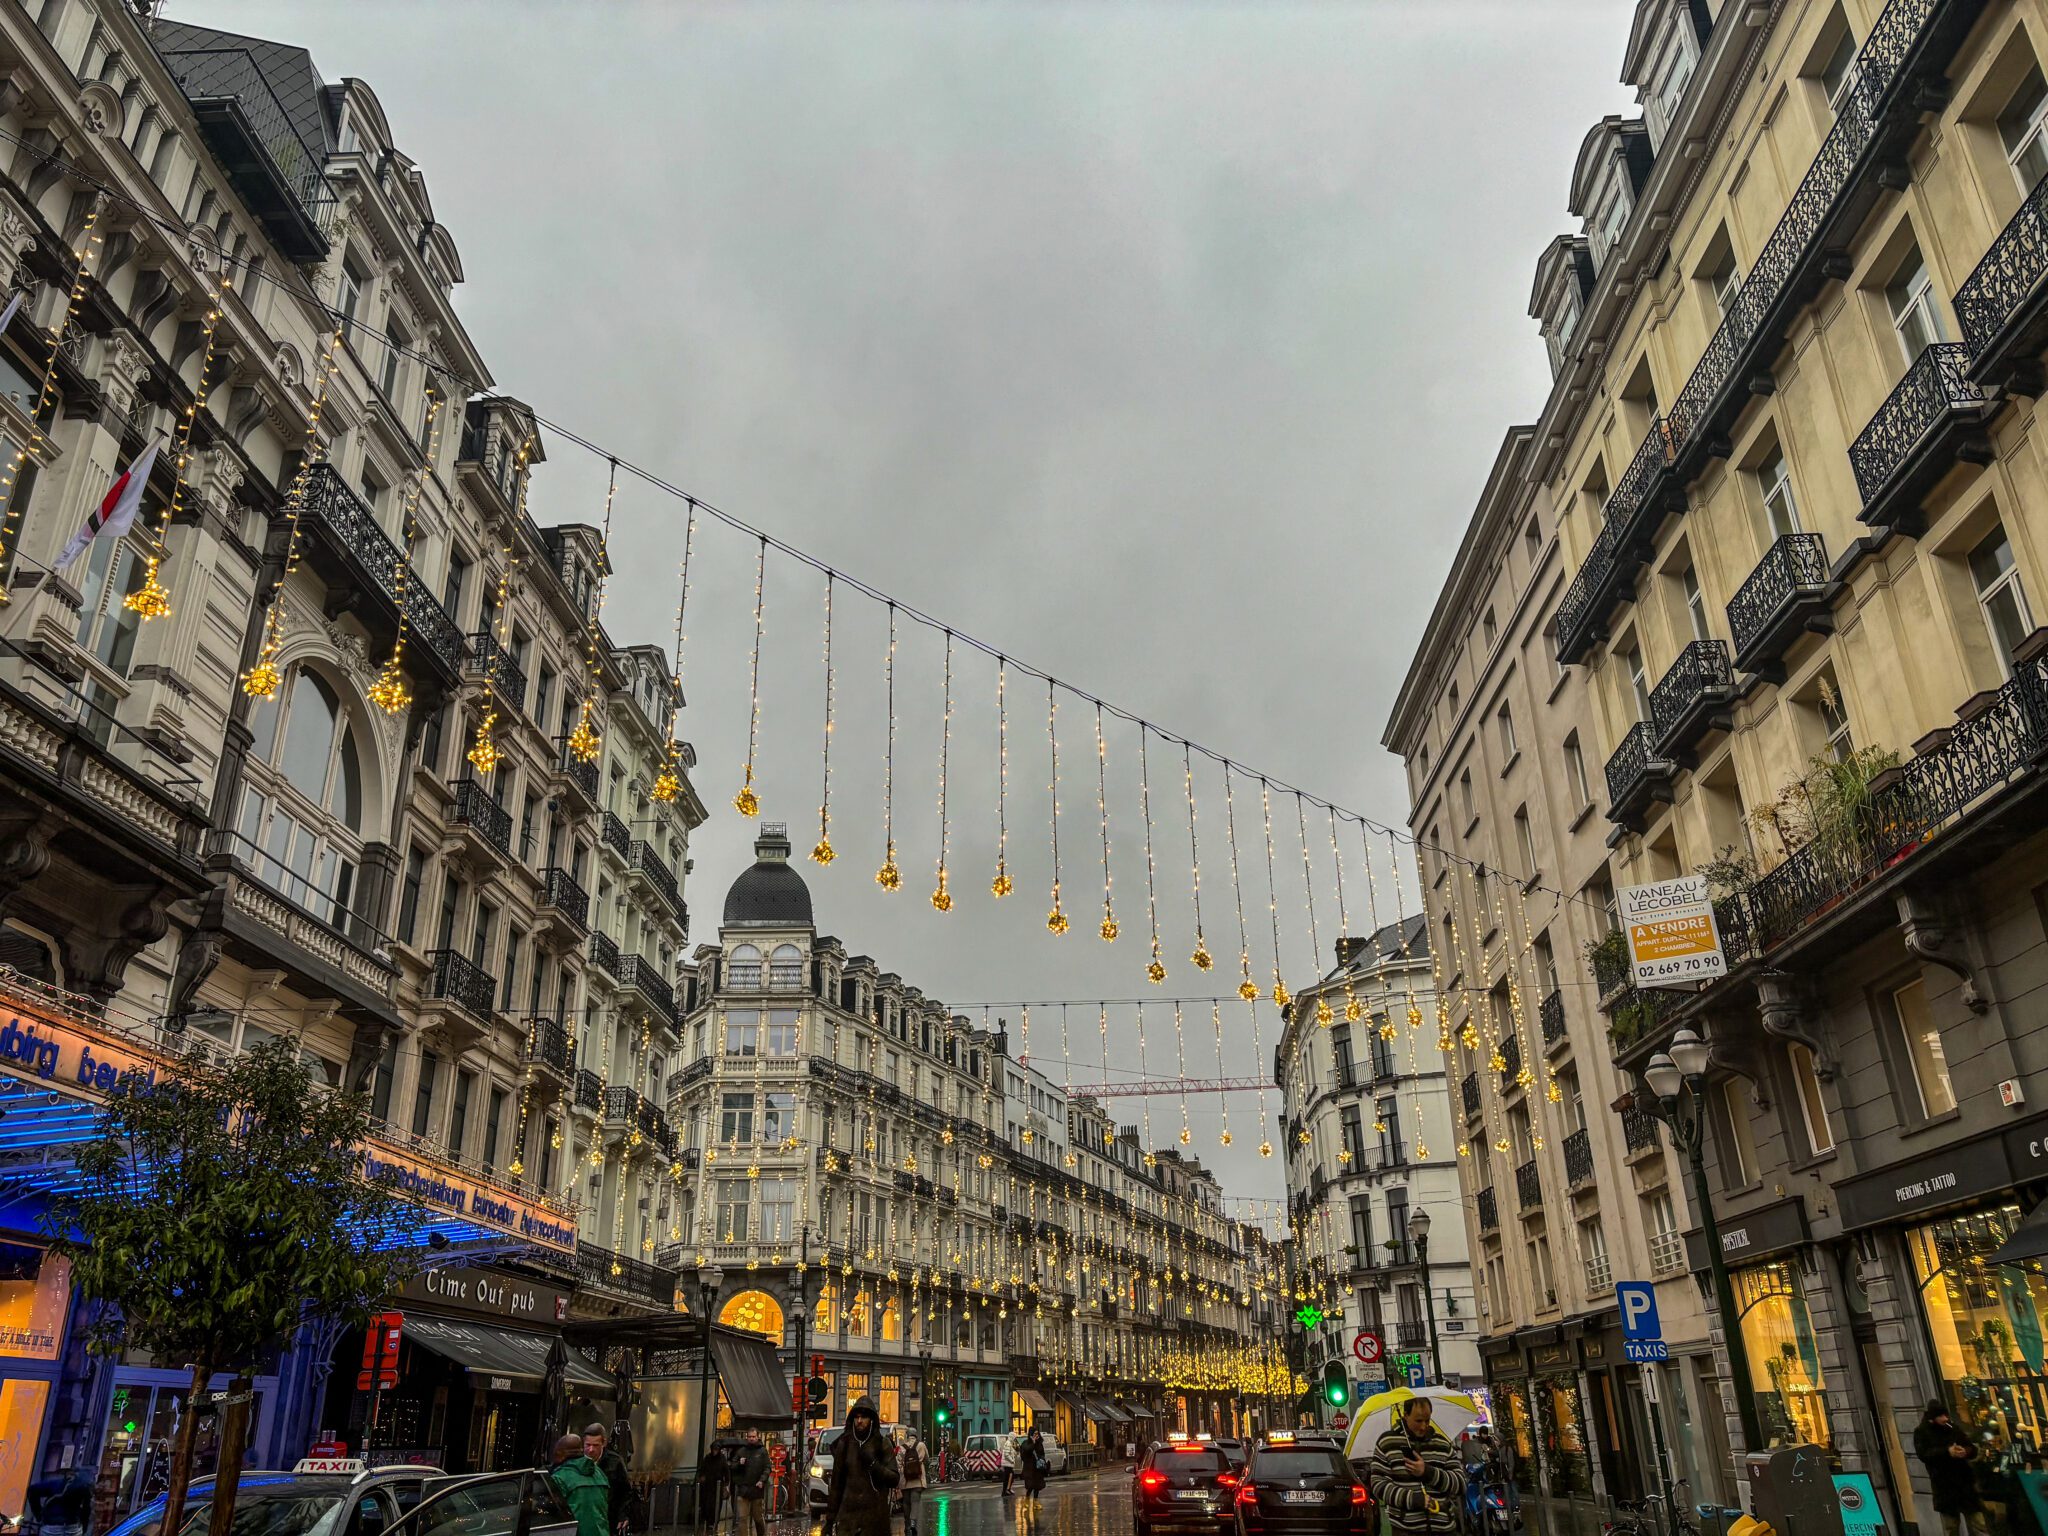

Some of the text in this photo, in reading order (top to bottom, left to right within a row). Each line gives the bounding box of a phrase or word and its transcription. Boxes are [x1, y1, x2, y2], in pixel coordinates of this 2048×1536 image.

[1629, 881, 1697, 901] VANEAU
[1629, 893, 1703, 913] LECOBEL
[1636, 917, 1706, 938] A VENDRE
[1660, 942, 1696, 952] CHAMBRES
[1639, 956, 1720, 977] 02 669 70 90
[1895, 1172, 1956, 1203] PIERCING & TATTOO
[426, 1268, 467, 1298] Time
[477, 1279, 504, 1306] Out
[511, 1290, 535, 1314] pub
[1623, 1290, 1651, 1330] P
[1625, 1345, 1667, 1358] TAXIS
[1409, 1368, 1422, 1387] P
[1334, 1417, 1348, 1426] STOP
[309, 1461, 348, 1471] TAXI
